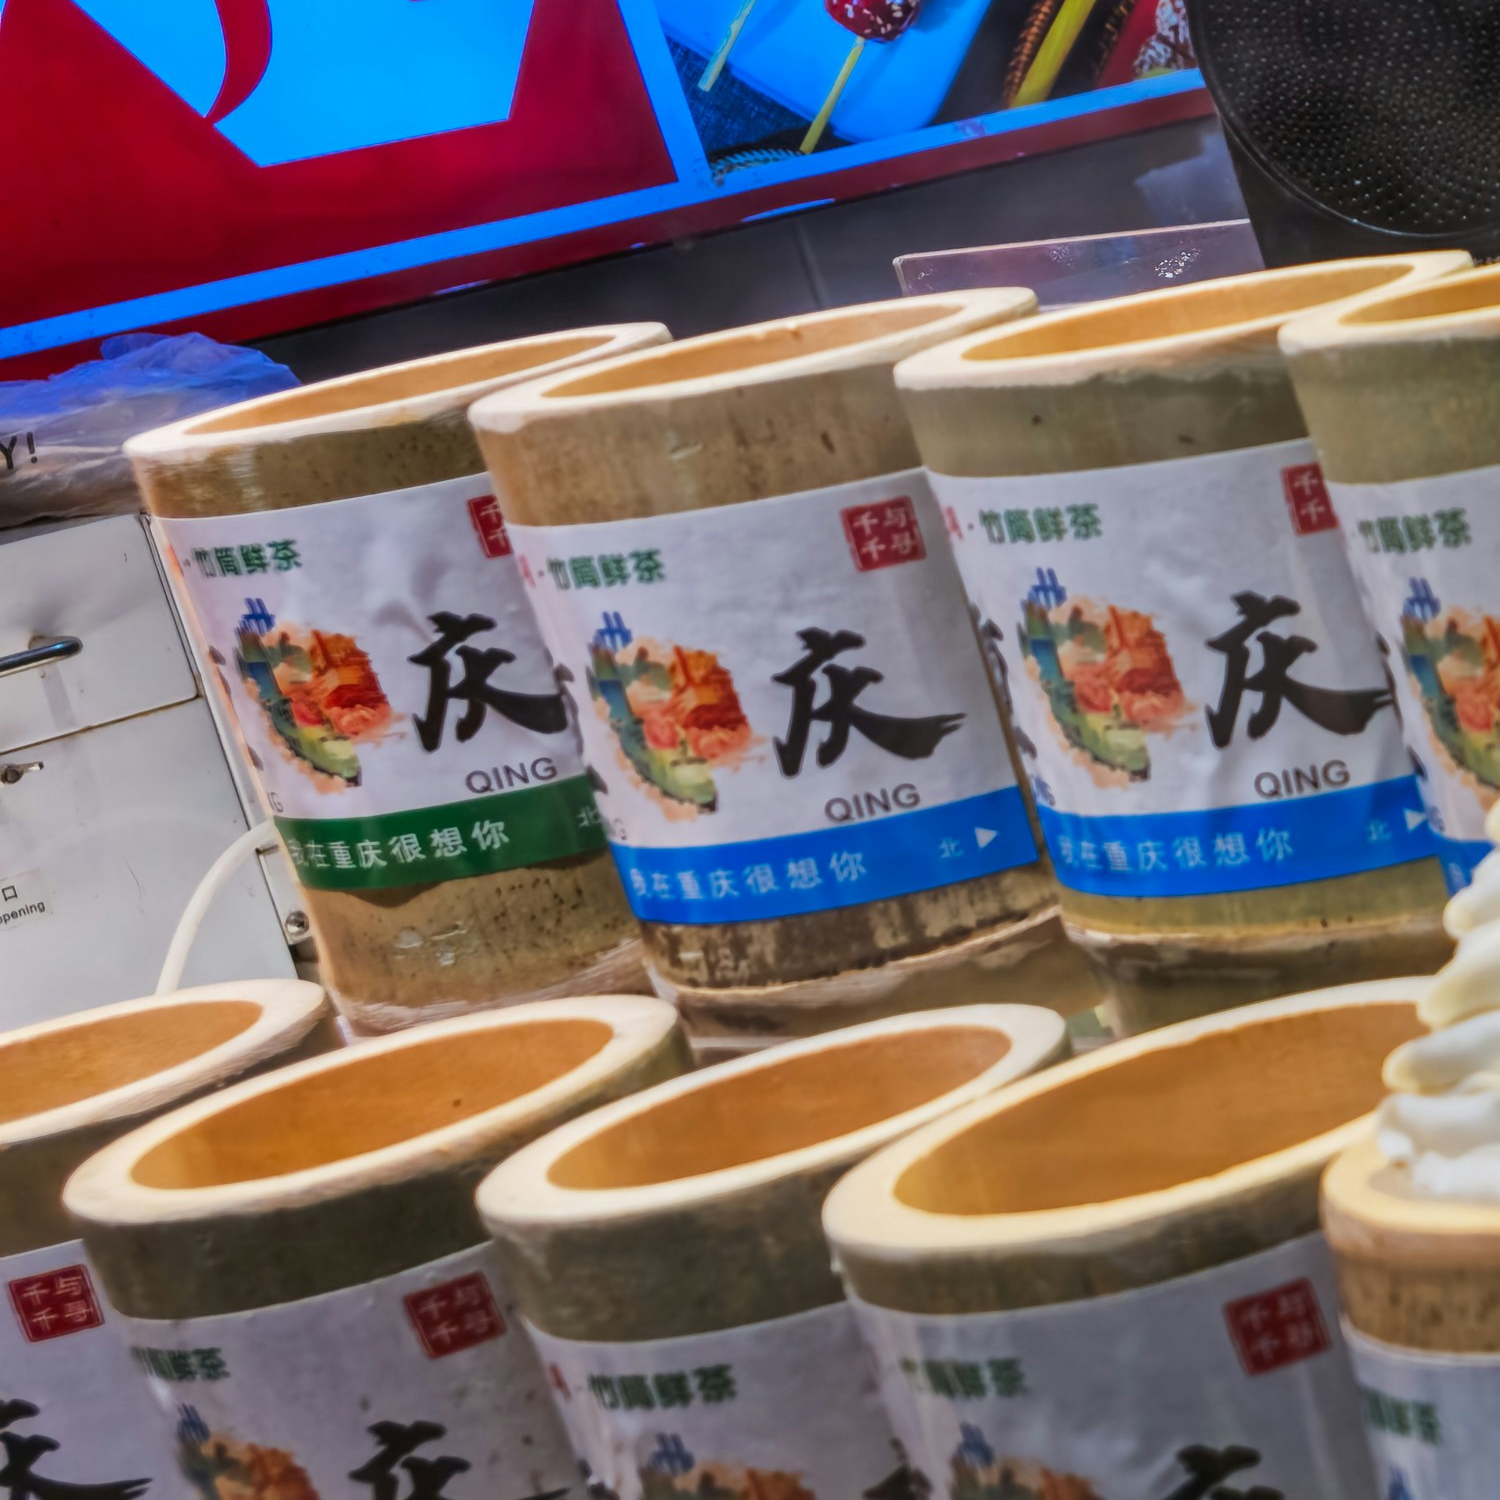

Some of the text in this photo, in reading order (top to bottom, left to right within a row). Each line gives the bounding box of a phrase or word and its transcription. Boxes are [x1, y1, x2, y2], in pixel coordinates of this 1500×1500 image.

[407, 611, 569, 753] 庆
[770, 626, 968, 780] 庆
[1205, 589, 1396, 750] 庆
[464, 756, 559, 795] QING
[824, 782, 922, 825] QING
[1254, 759, 1352, 800] QING
